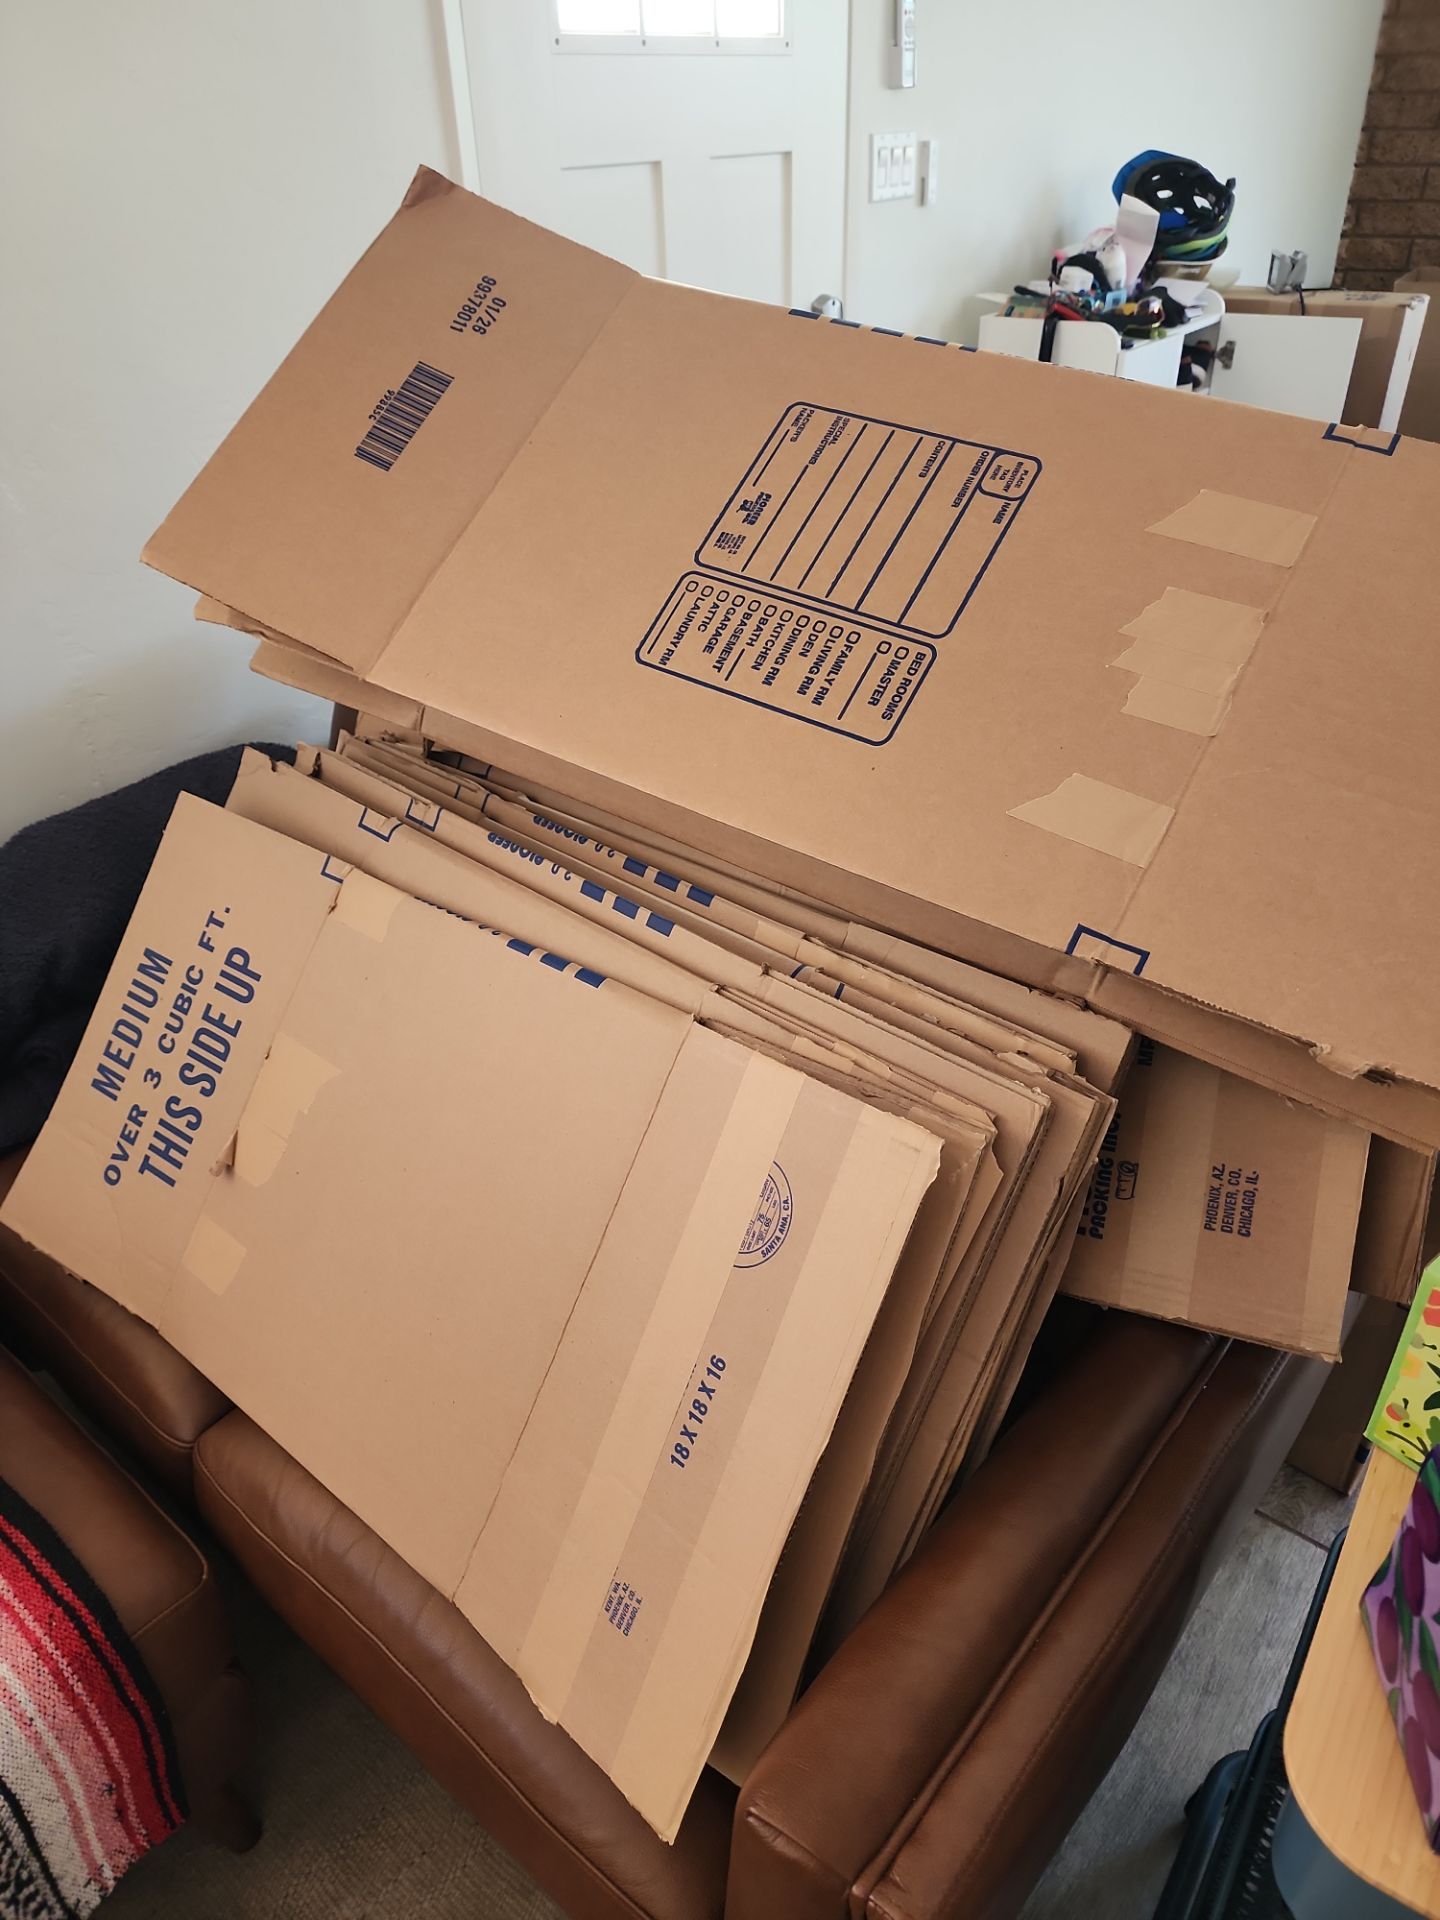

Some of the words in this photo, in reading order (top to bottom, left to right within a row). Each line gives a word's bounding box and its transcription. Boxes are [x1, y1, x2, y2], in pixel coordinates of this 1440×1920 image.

[449, 275, 497, 333] 99378011
[472, 297, 507, 335] 01/26
[368, 389, 396, 421] 99885C
[791, 408, 808, 427] NAME
[808, 415, 843, 465] INSTRUCTIONS
[828, 416, 850, 446] SPECIAL
[919, 441, 946, 478] CONTENTS
[971, 451, 990, 477] ORDER
[951, 476, 975, 508] NUMBER
[1014, 470, 1029, 489] PLACE
[993, 502, 1011, 525] NAME
[669, 597, 706, 649] LAUNDRY
[697, 601, 720, 633] ATTIC
[702, 607, 737, 655] GARAGE
[745, 617, 769, 648] BATH
[658, 648, 675, 666] RM
[712, 612, 753, 673] BASEMENT
[750, 622, 786, 671] KITCHEN
[774, 627, 802, 666] DINING
[798, 633, 819, 658] DEN
[808, 638, 836, 676] LIVING
[761, 666, 780, 687] RM
[824, 644, 854, 687] FAMILY
[906, 652, 927, 676] BED
[796, 675, 815, 696] RM
[811, 686, 830, 707] RM
[867, 659, 901, 706] MASTER
[880, 677, 913, 721] ROOMS
[90, 947, 174, 1102] MEDIUM
[103, 1103, 148, 1187] OVER
[143, 1068, 163, 1089] 3
[157, 964, 204, 1055] CUBIC
[197, 906, 231, 953] FT.
[138, 1095, 203, 1188] THIS
[178, 1002, 243, 1098] SIDE
[213, 946, 262, 1004] UP
[1212, 1163, 1225, 1181] AZ.
[1227, 1168, 1242, 1186] CO.
[1245, 1171, 1259, 1185] IL.
[763, 1217, 772, 1228] 65
[1204, 1184, 1224, 1231] PHOENIX,
[1220, 1189, 1240, 1234] DENVER,
[1237, 1188, 1259, 1238] CHICAGO,
[761, 1235, 781, 1258] SANTA
[782, 1195, 791, 1211] CA.
[706, 1354, 726, 1380] 16
[697, 1380, 716, 1401] X
[688, 1398, 708, 1424] 18
[679, 1423, 698, 1446] X
[670, 1442, 690, 1468] 18
